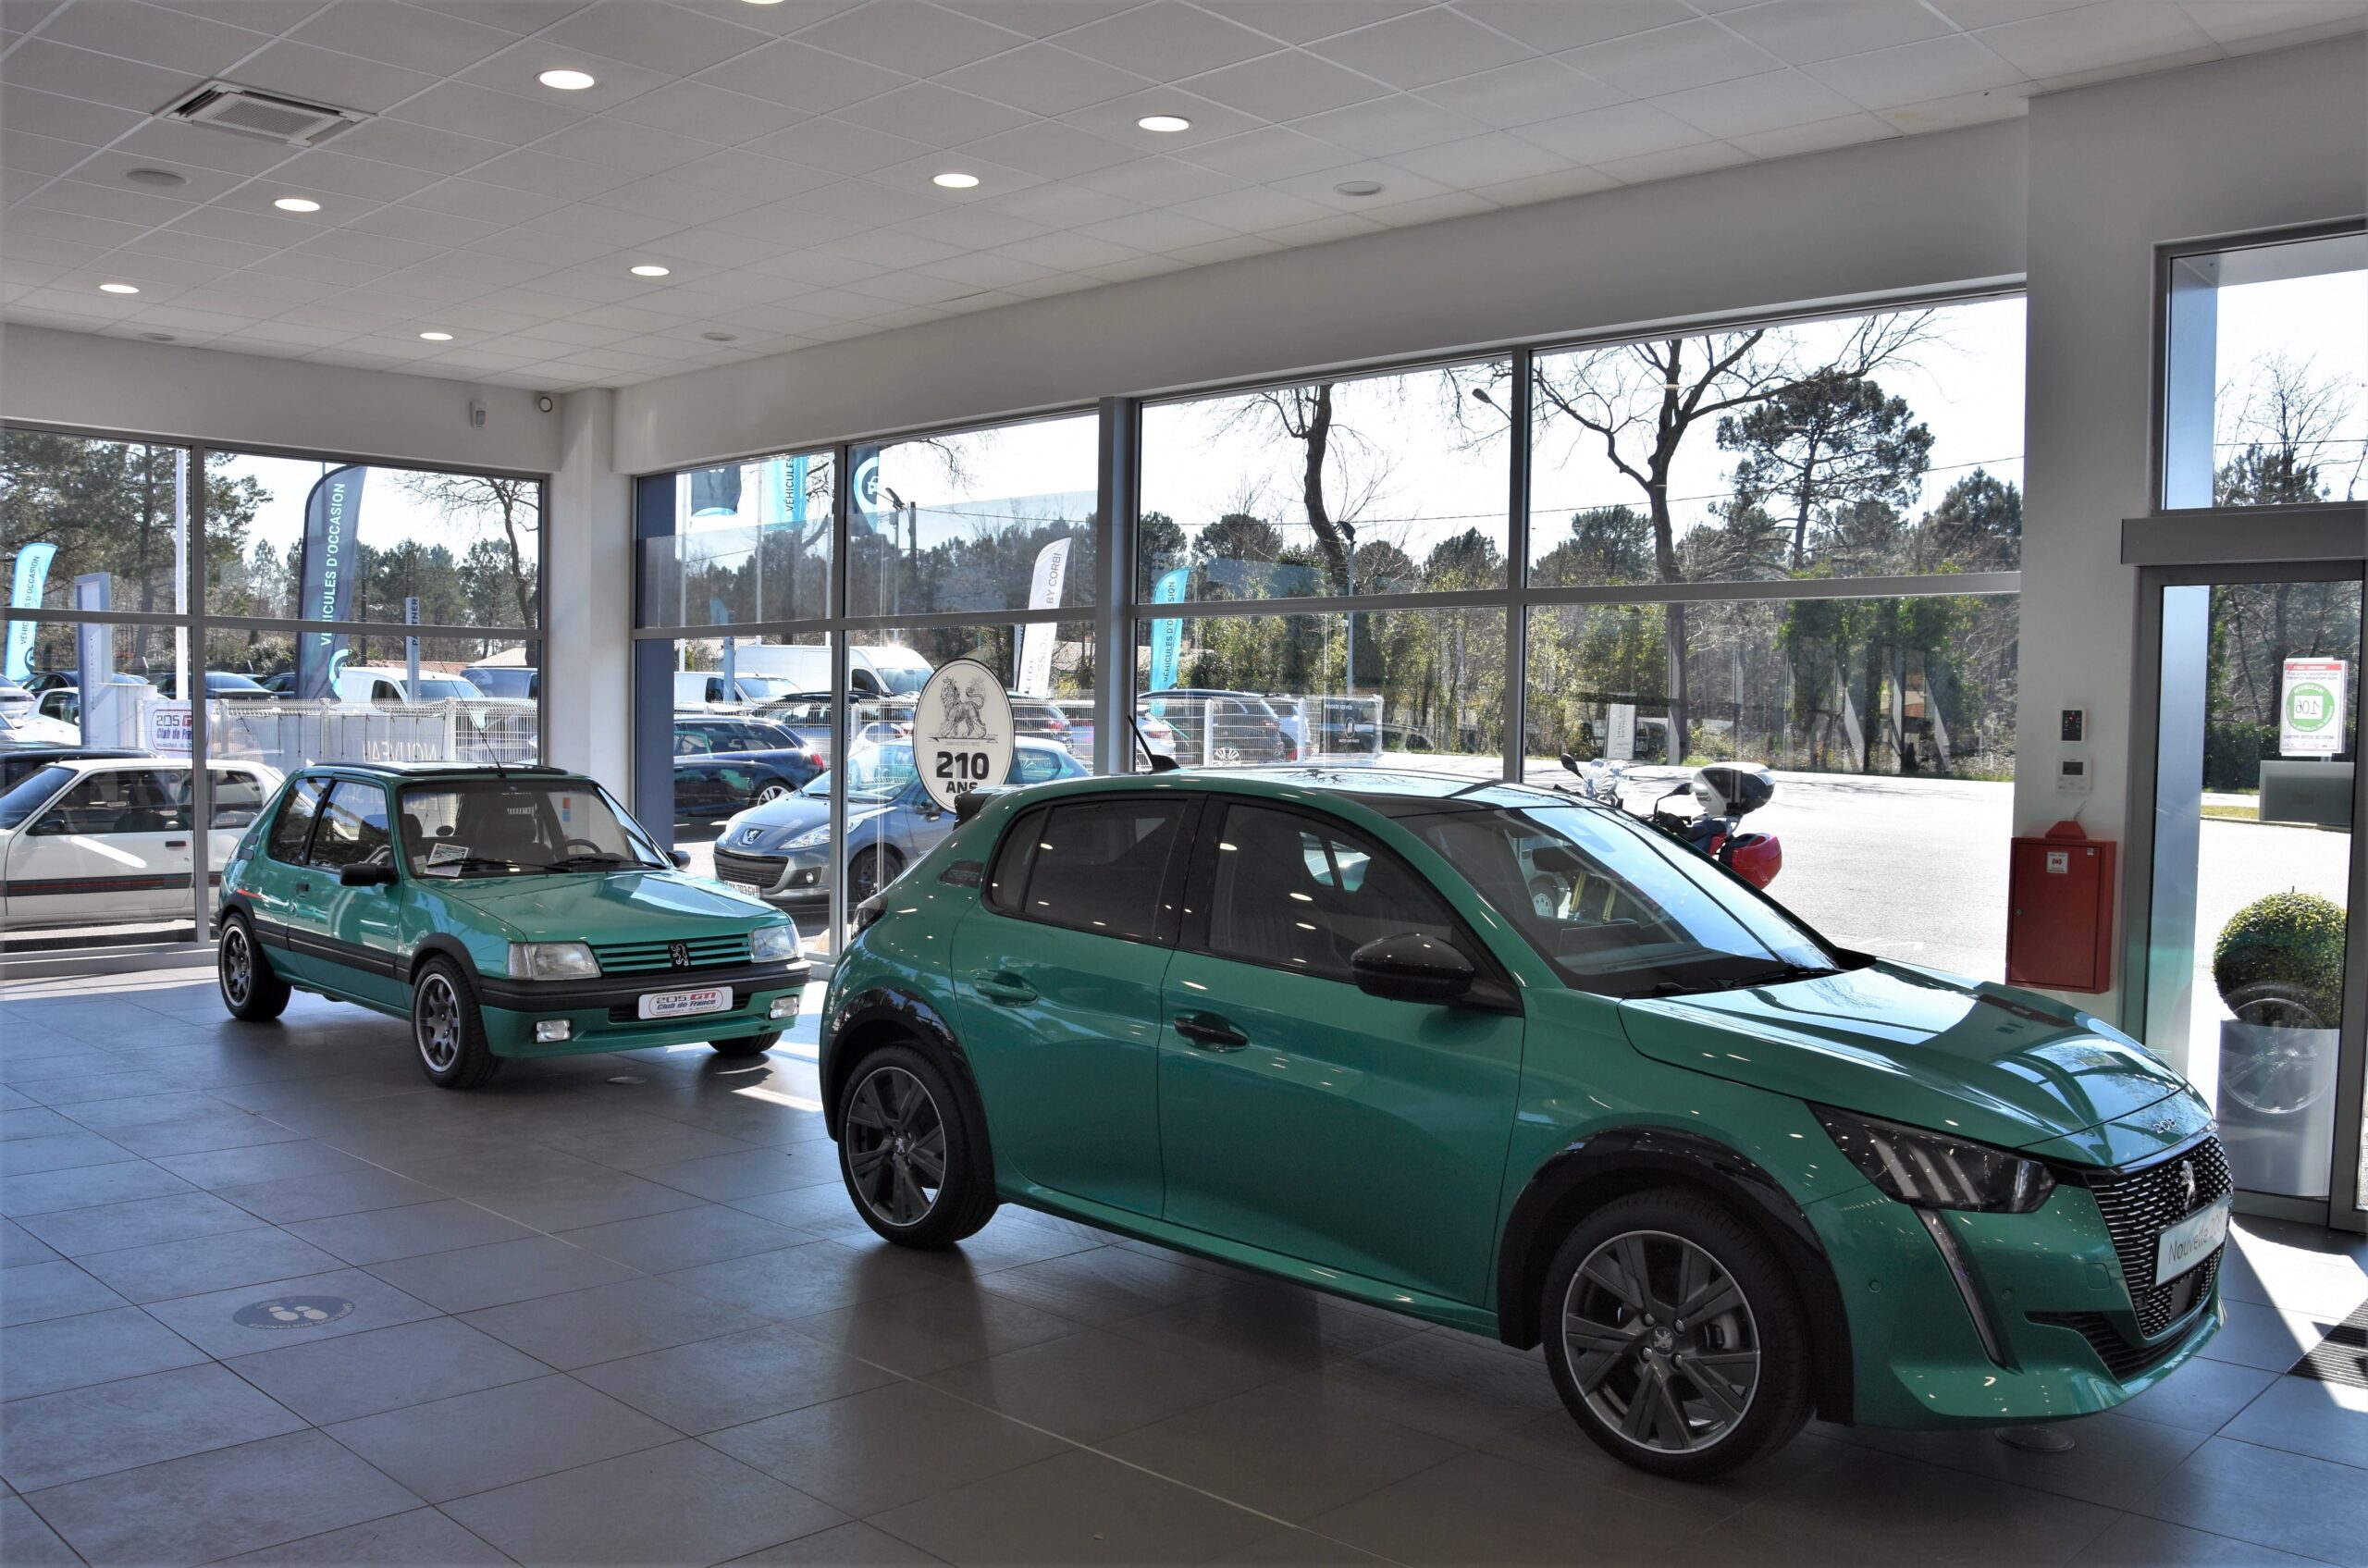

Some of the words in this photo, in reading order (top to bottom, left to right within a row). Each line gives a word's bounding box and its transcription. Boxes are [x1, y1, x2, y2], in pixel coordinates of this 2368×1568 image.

[326, 483, 346, 567] D'OCCASION
[1049, 553, 1063, 587] CORBI
[320, 571, 337, 646] VICULES
[1046, 589, 1056, 604] BY
[1166, 582, 1176, 634] D'OSION
[20, 603, 31, 645] VÉHICS
[1163, 636, 1173, 683] VÉHICULES
[156, 714, 180, 727] 205
[936, 751, 990, 781] 210
[656, 994, 687, 1004] 205
[690, 992, 717, 1001] GTI
[657, 1002, 676, 1011] Club
[689, 999, 717, 1007] France
[2168, 1224, 2209, 1265] Nouvelle
